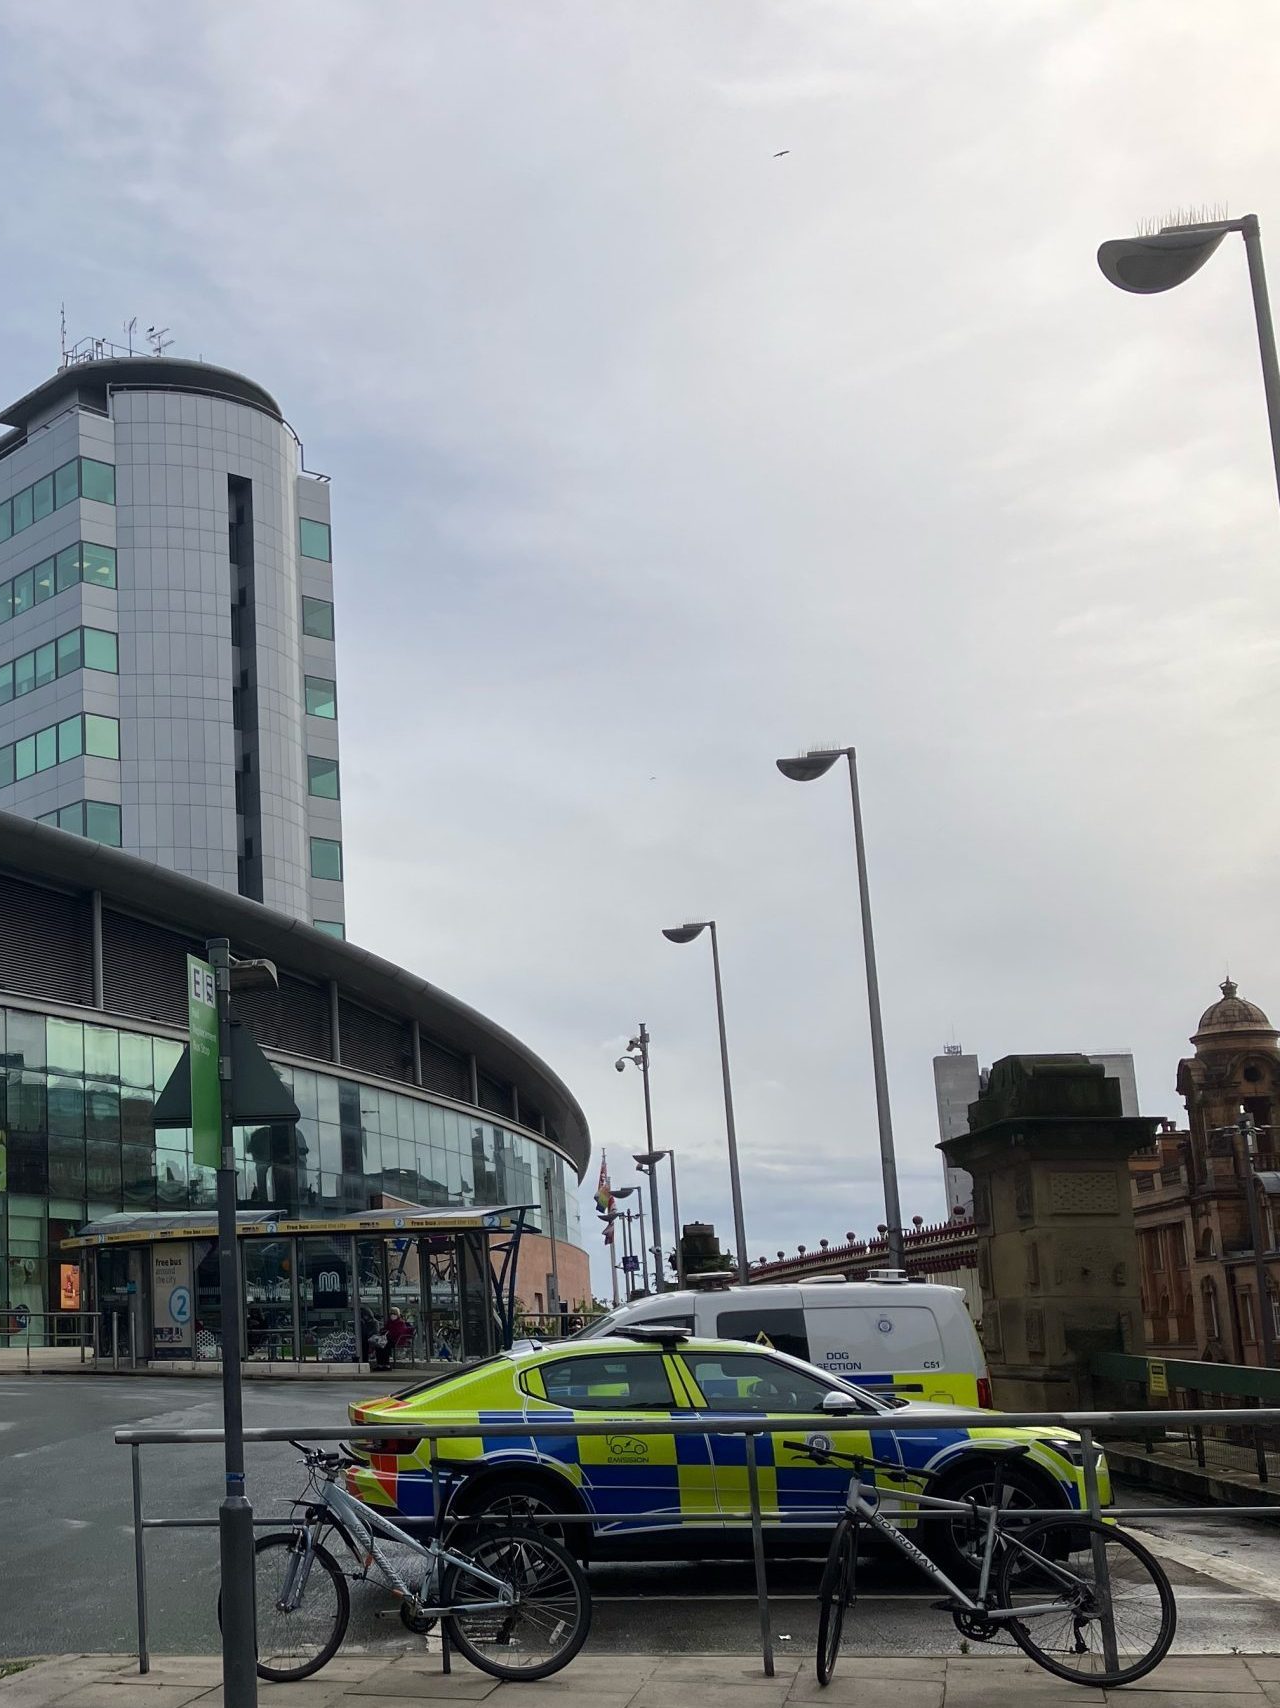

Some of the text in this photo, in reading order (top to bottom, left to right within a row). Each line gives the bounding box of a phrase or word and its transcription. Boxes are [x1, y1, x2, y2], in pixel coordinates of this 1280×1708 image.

[411, 1219, 424, 1227] free
[155, 1258, 182, 1267] free bus
[166, 1275, 176, 1285] city
[177, 1295, 187, 1316] 2
[826, 1352, 849, 1360] DOG
[816, 1362, 862, 1371] SECTION
[923, 1361, 941, 1369] C51
[874, 1514, 938, 1573] BOARDMAN
